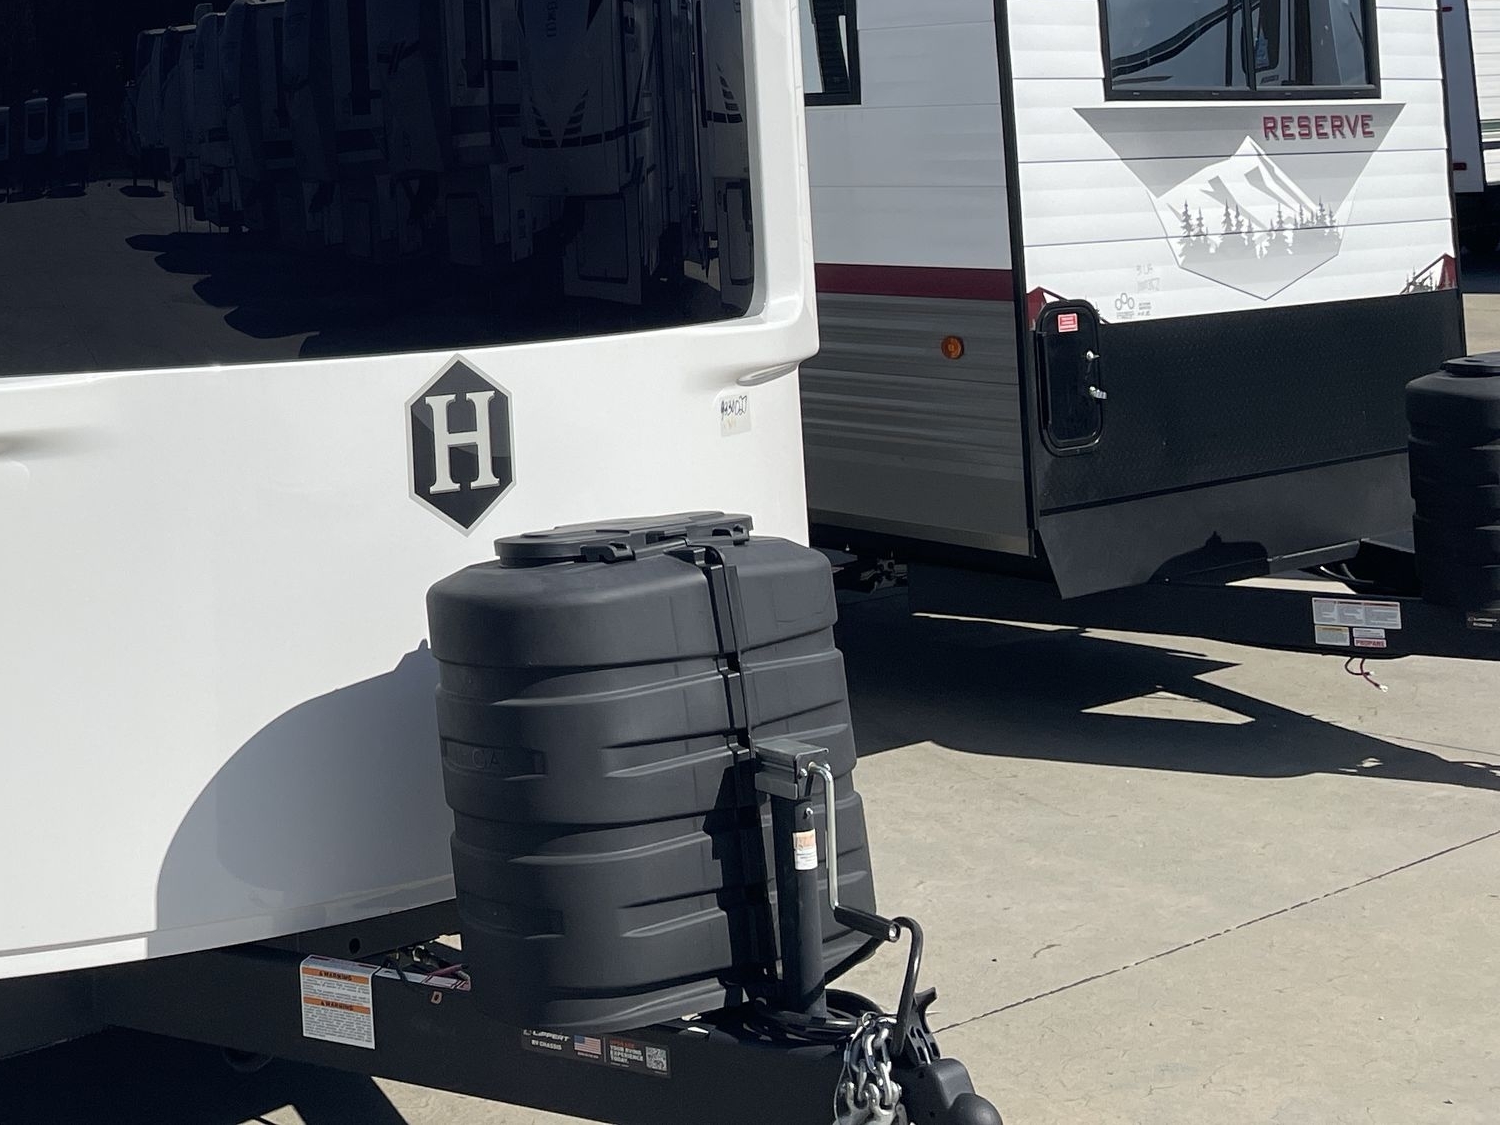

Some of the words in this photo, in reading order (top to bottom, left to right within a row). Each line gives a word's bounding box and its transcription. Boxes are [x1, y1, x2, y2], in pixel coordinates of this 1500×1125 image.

[1262, 114, 1375, 141] RESERVE
[425, 389, 501, 495] H
[533, 1030, 570, 1042] LIPPERT
